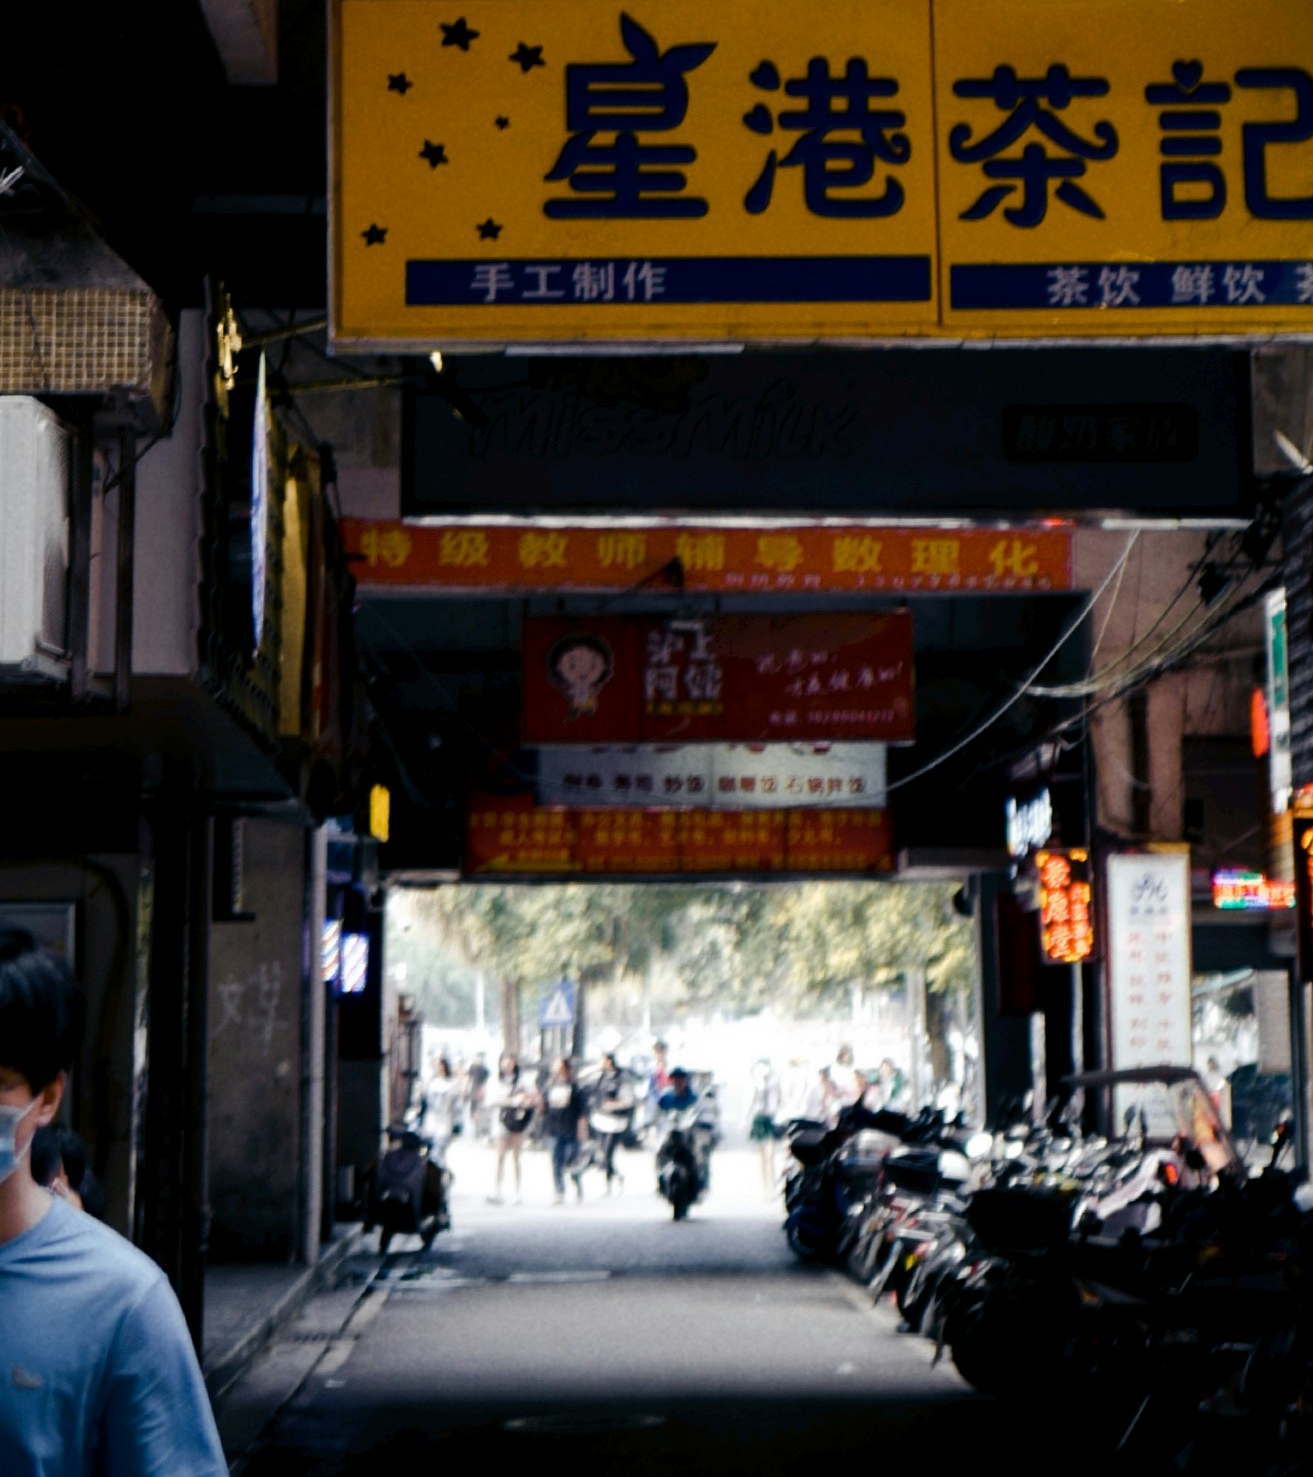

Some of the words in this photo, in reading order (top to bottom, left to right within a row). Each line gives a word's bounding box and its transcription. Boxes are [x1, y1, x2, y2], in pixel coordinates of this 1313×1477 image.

[468, 261, 669, 304] 手工制作
[1045, 263, 1140, 309] 茶饮
[1170, 263, 1267, 309] 鲜饮
[359, 527, 1041, 577] 特级教师辅导数理化
